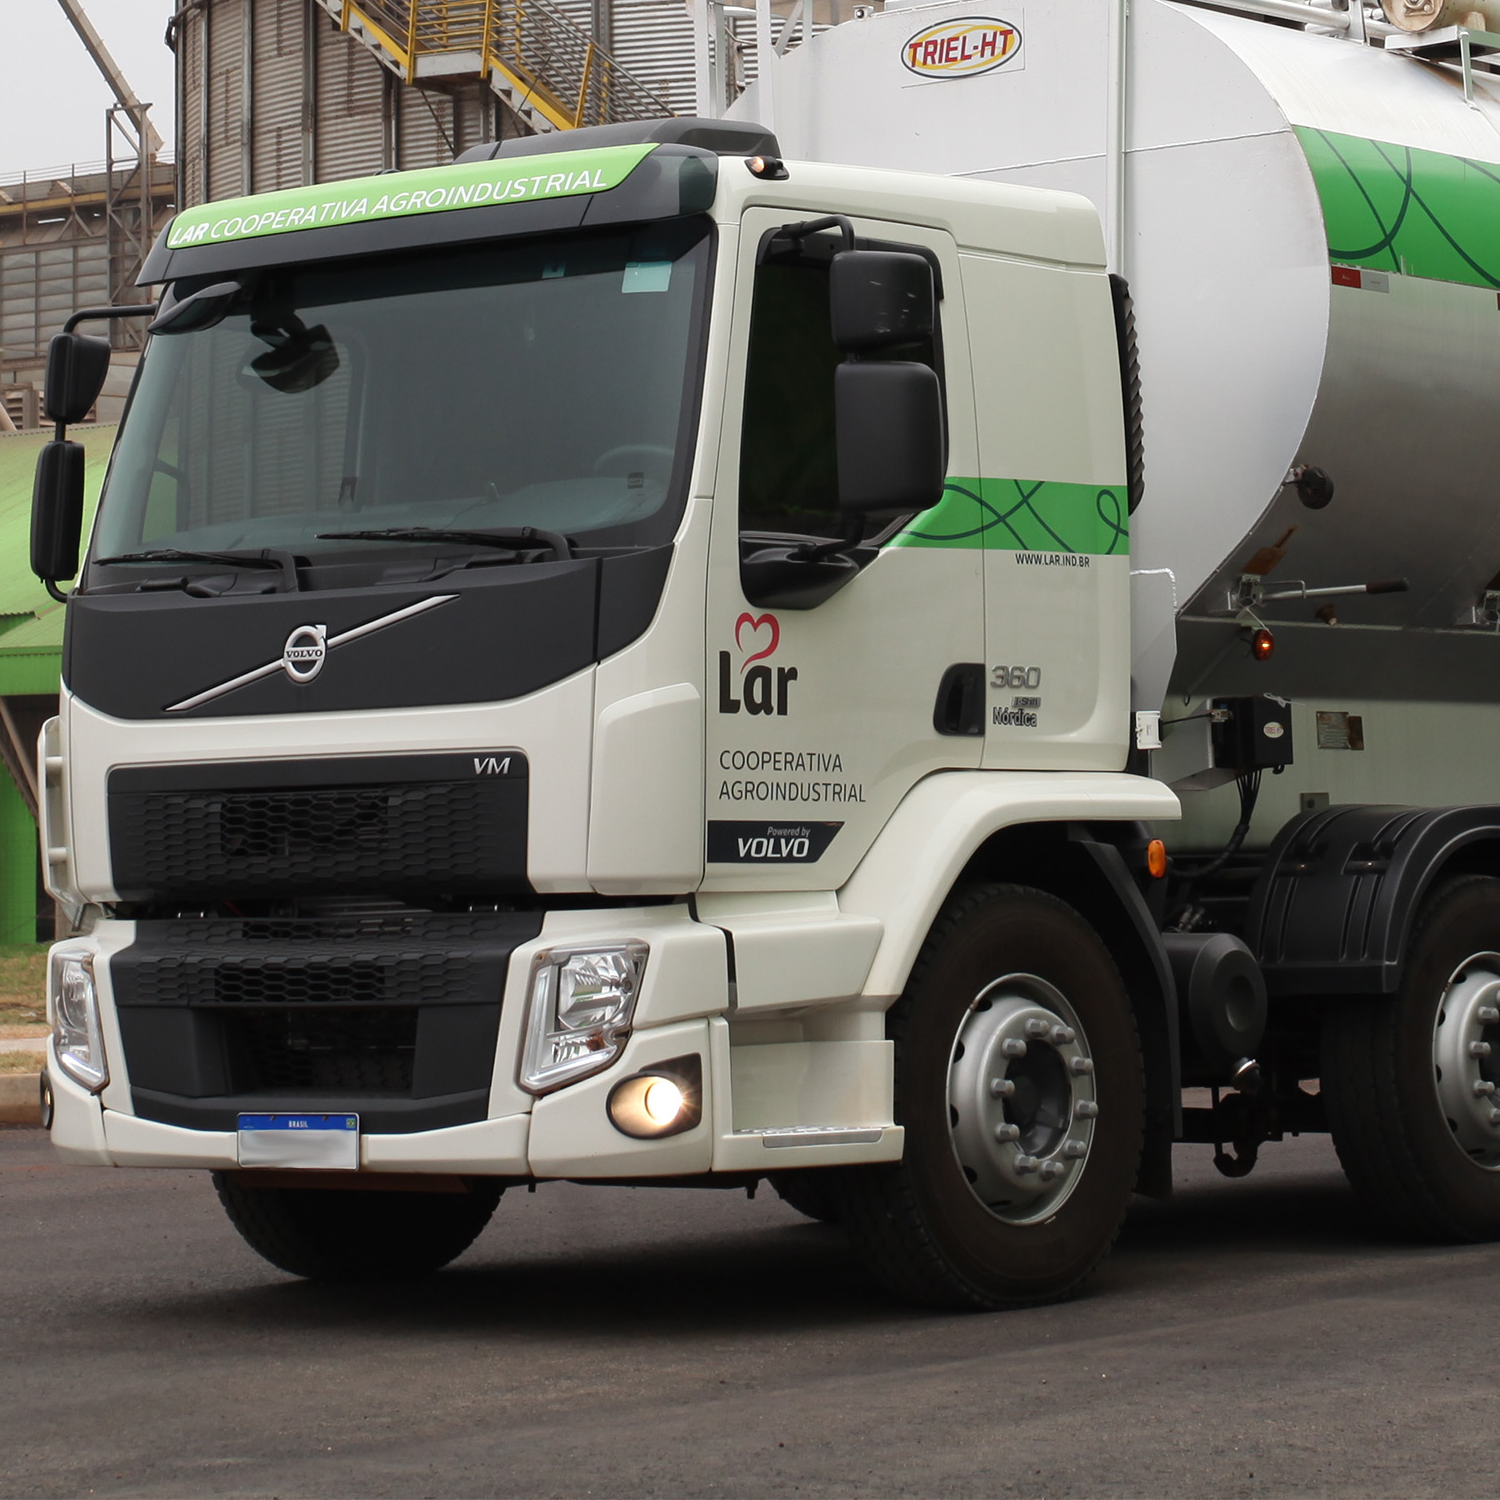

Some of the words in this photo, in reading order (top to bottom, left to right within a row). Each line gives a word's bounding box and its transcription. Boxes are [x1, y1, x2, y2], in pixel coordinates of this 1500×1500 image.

[909, 29, 1013, 68] TRIEL-HT
[169, 222, 209, 245] LAR
[210, 198, 368, 239] COOPERATIVA
[371, 169, 607, 212] AGROINDUSTRIAL
[1015, 553, 1090, 567] WWW.LAR.IND.BR
[286, 649, 323, 659] VOLVO
[719, 650, 798, 716] Lar
[990, 665, 1041, 689] 360
[993, 707, 1037, 727] Nórdica
[473, 758, 510, 775] VM
[719, 750, 842, 772] COOPERATIVA
[719, 781, 866, 802] AGROINDUSTRIAL
[767, 826, 800, 836] Powered
[801, 827, 811, 838] by
[738, 838, 809, 857] VOLVO
[288, 1120, 308, 1128] BRASIL
